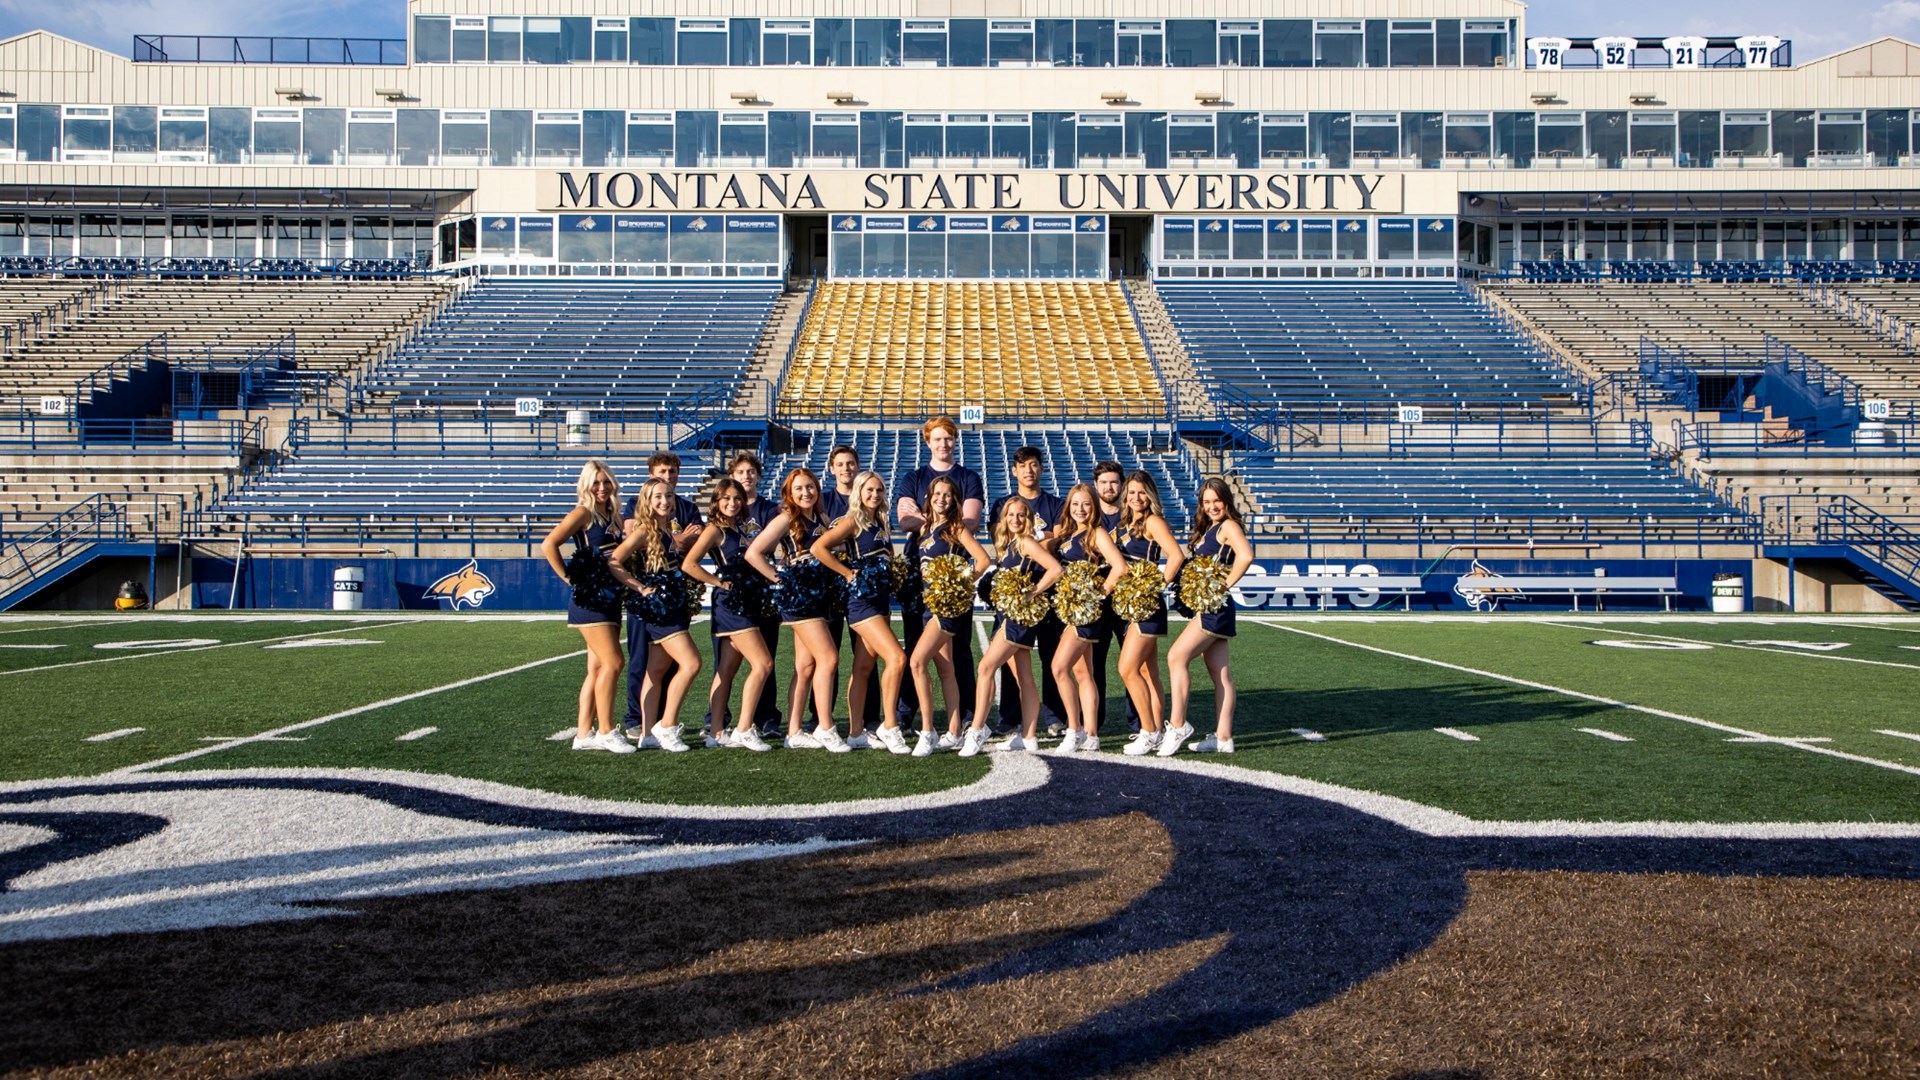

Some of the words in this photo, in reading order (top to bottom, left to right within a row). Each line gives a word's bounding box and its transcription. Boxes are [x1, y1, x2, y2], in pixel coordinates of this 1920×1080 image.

[1540, 48, 1558, 65] 78
[1607, 47, 1624, 64] 52
[1676, 47, 1693, 64] 21
[1749, 47, 1767, 64] 77
[555, 173, 826, 208] MONTANA
[864, 173, 1022, 208] STATE
[1055, 173, 1386, 210] UNIVERSITY
[44, 400, 61, 410] 102
[518, 401, 537, 412] 103
[1868, 403, 1886, 414] 106
[963, 409, 981, 420] 104
[1402, 410, 1420, 421] 105
[334, 582, 358, 590] CATS
[1231, 564, 1380, 607] CATS
